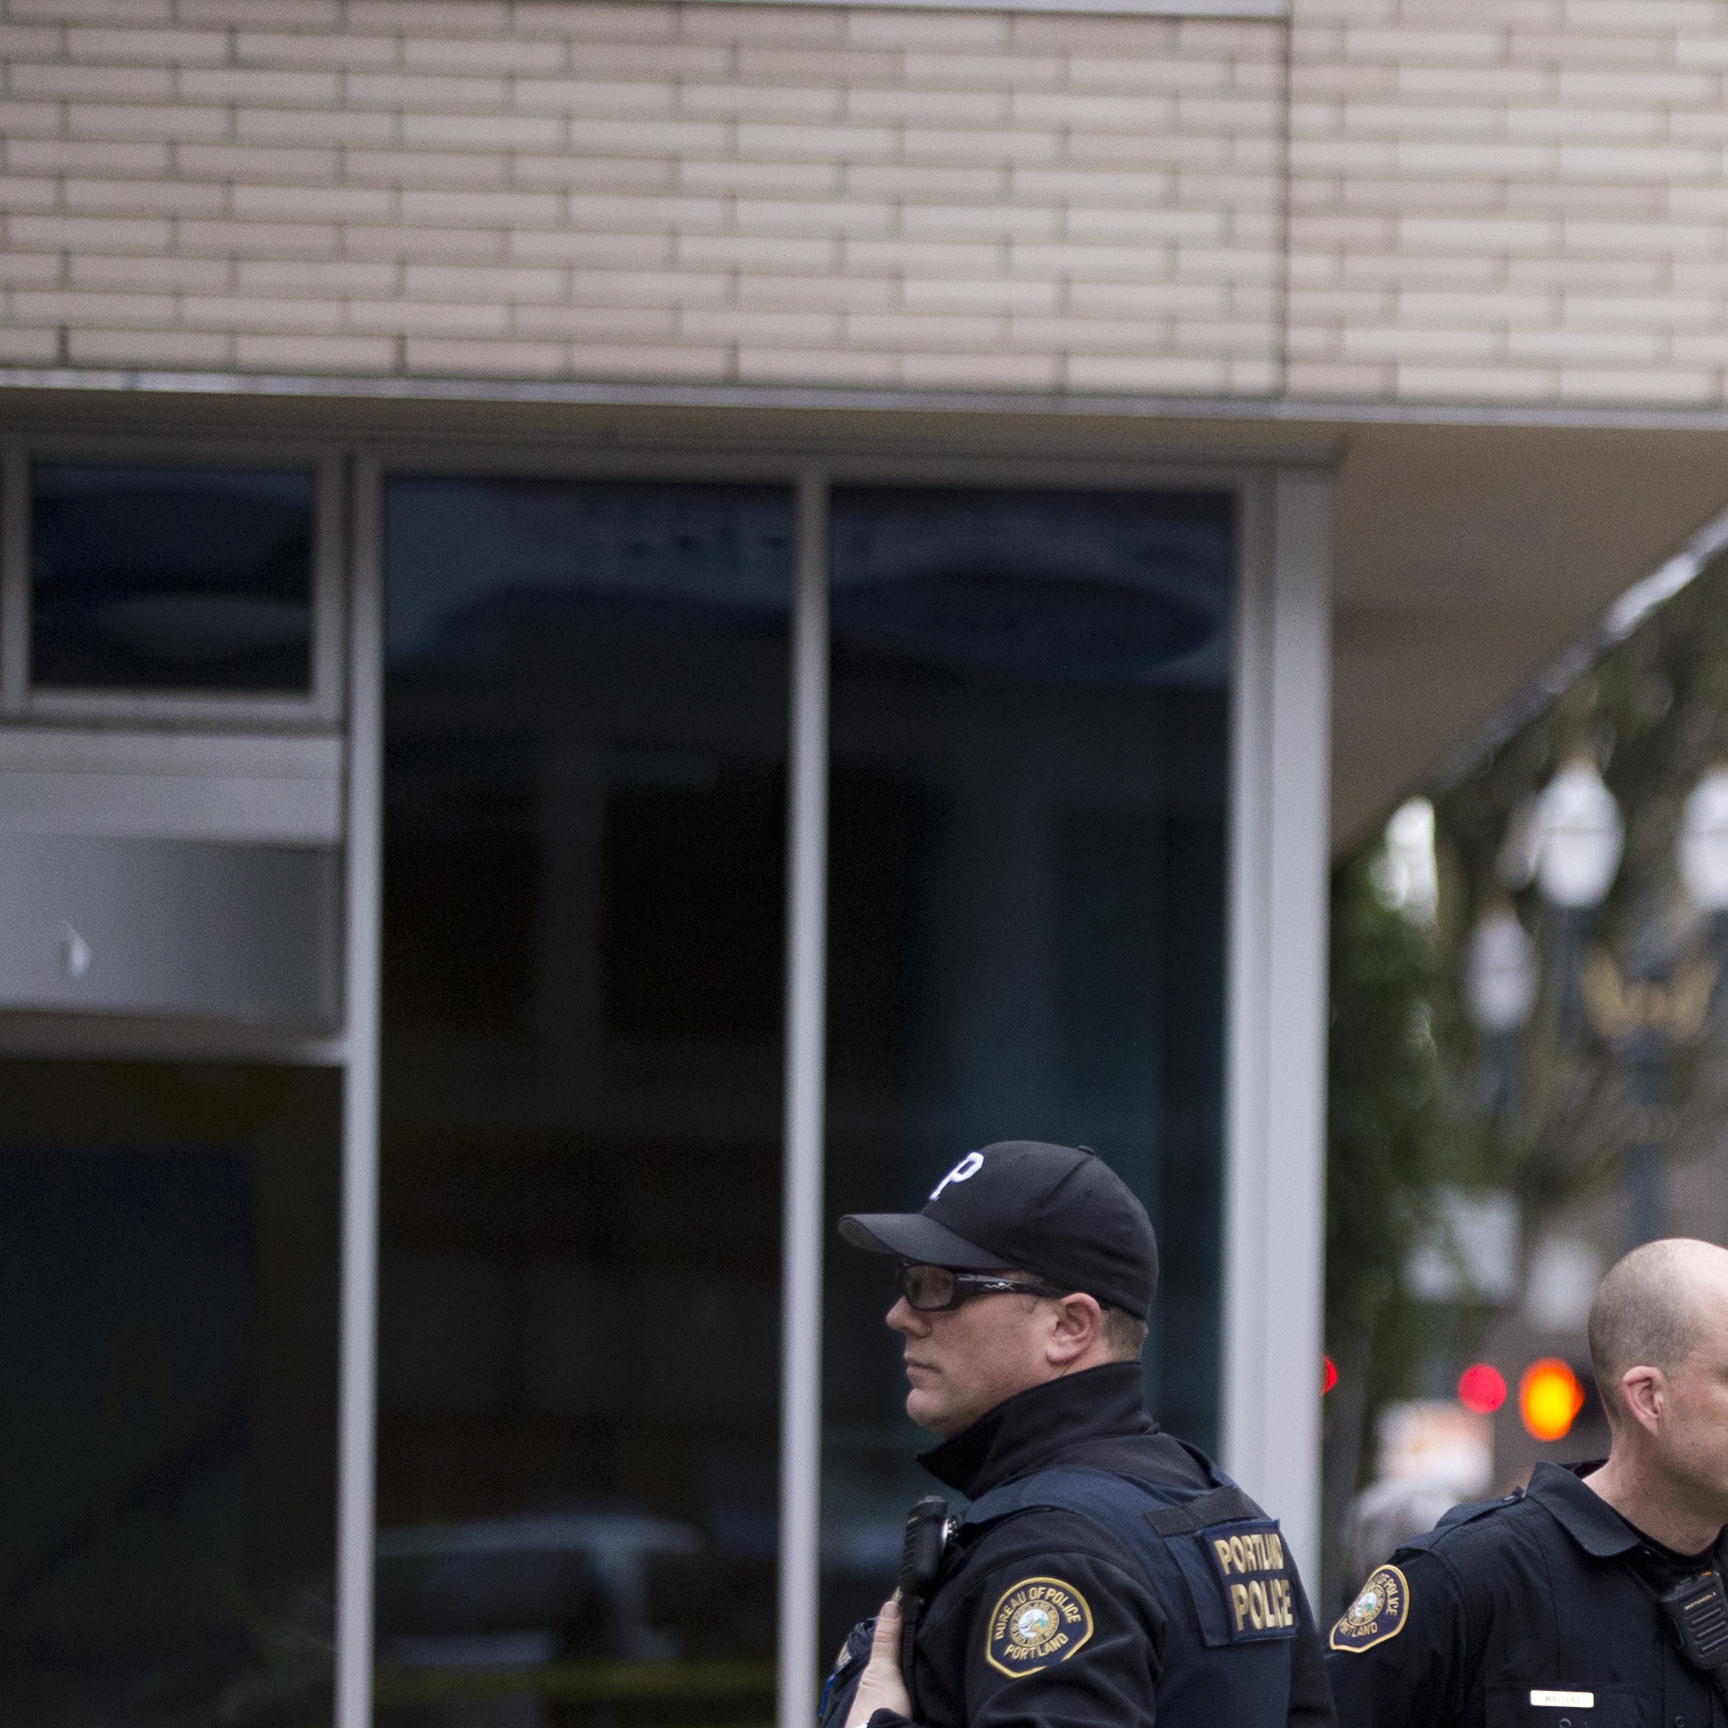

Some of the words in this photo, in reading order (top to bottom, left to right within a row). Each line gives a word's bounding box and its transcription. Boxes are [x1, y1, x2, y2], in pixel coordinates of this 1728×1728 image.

[929, 1151, 985, 1202] P
[994, 1591, 1027, 1641] BUREAU
[1028, 1586, 1047, 1601] OF
[1045, 1587, 1082, 1624] POLICE
[1003, 1632, 1070, 1660] PORTLAND
